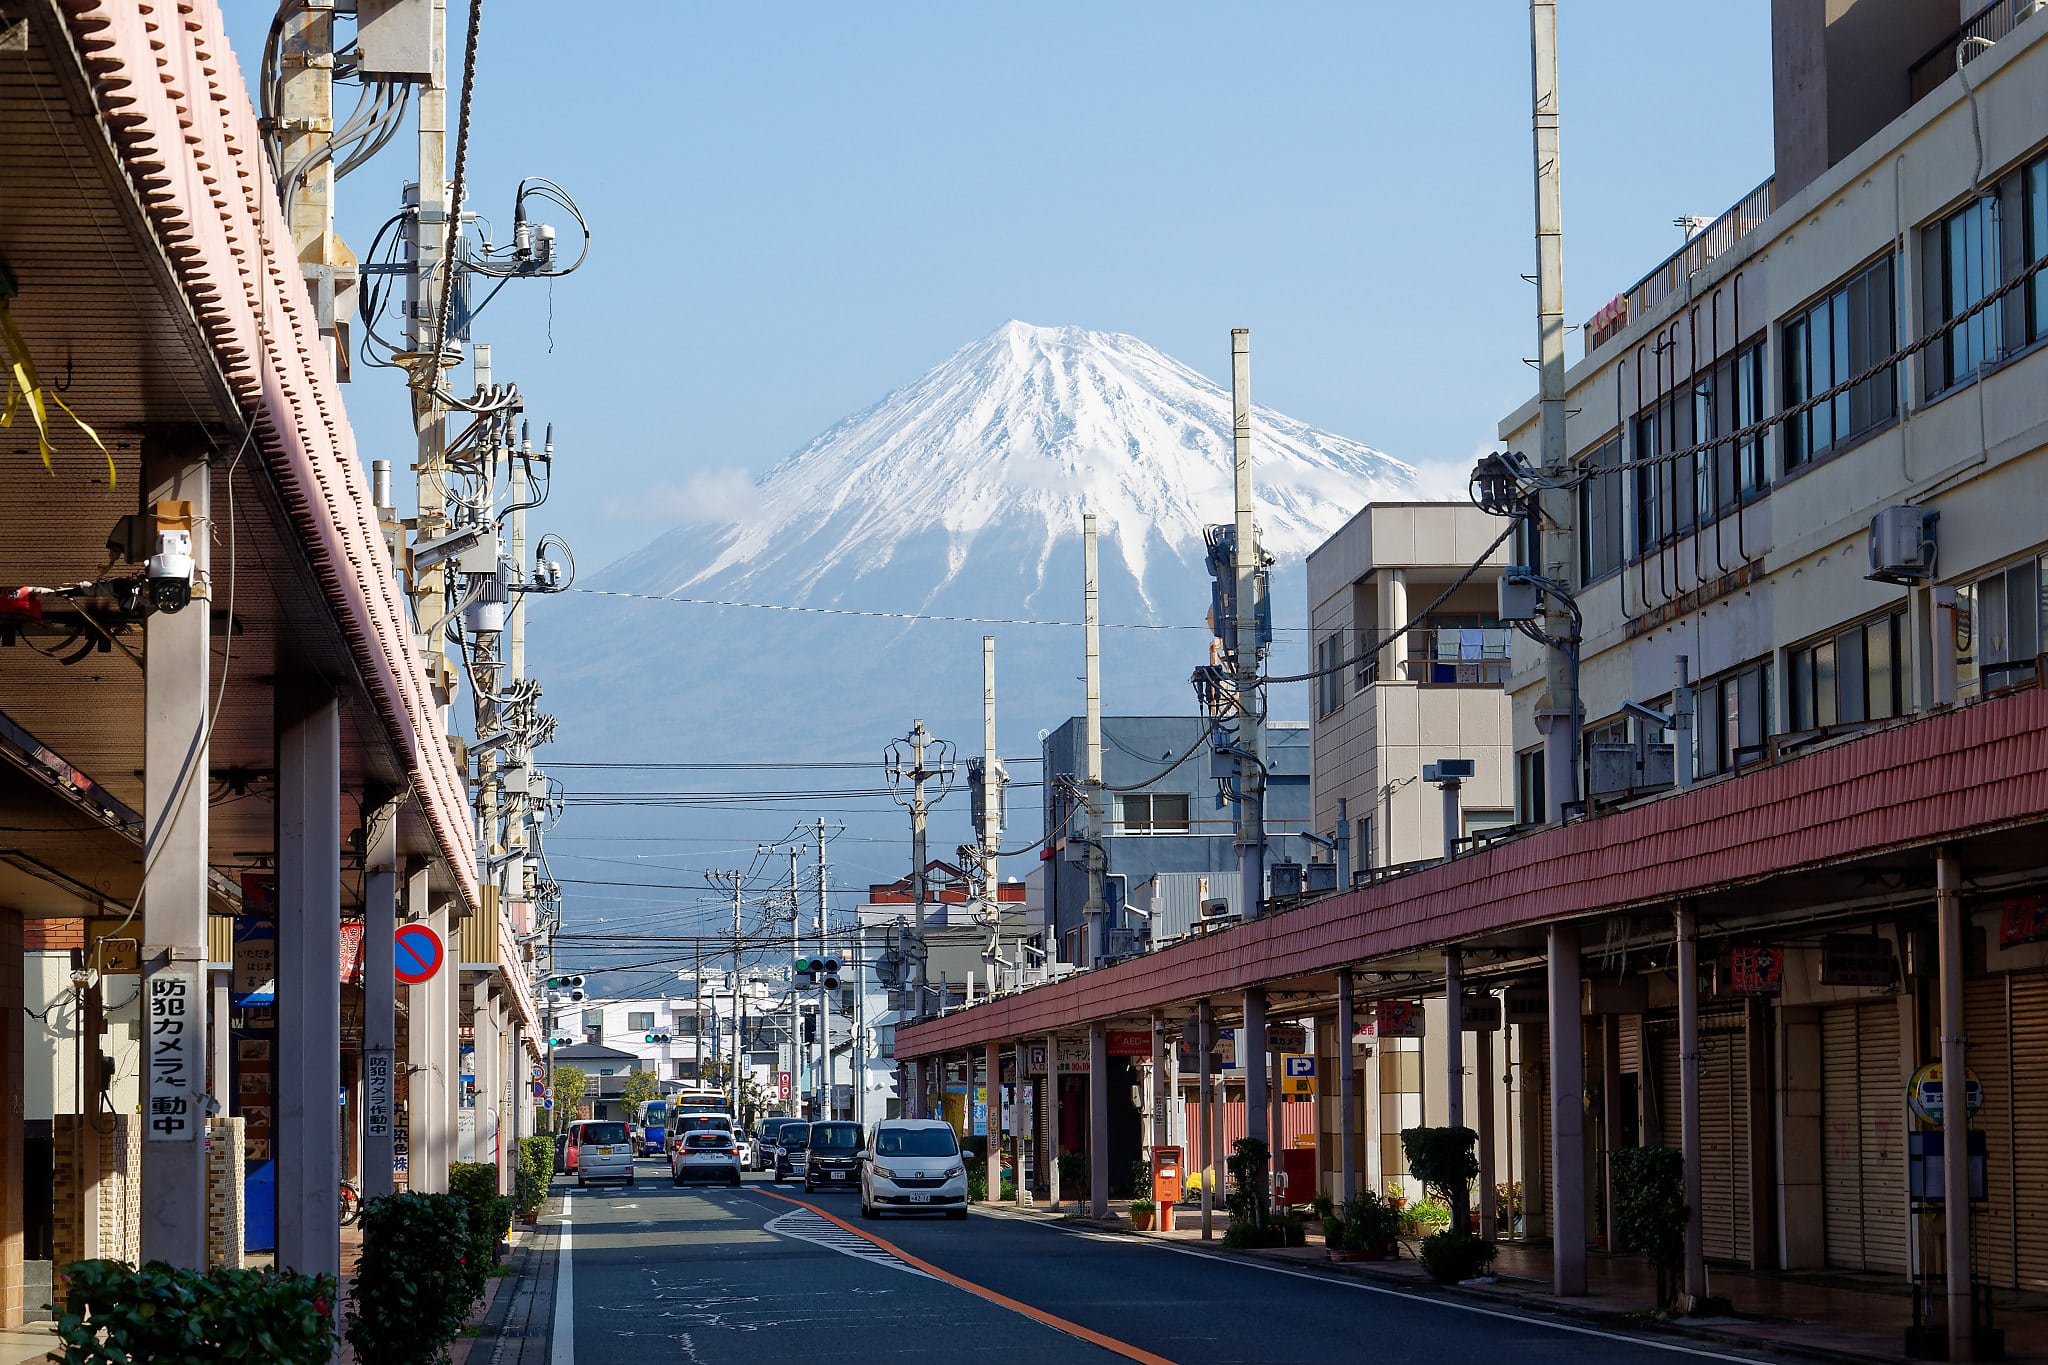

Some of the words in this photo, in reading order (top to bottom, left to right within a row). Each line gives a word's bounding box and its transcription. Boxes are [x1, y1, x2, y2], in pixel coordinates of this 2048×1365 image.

[247, 977, 274, 987] 富士
[1292, 1058, 1312, 1076] P
[370, 1057, 388, 1134] 防犯カメラ作動中
